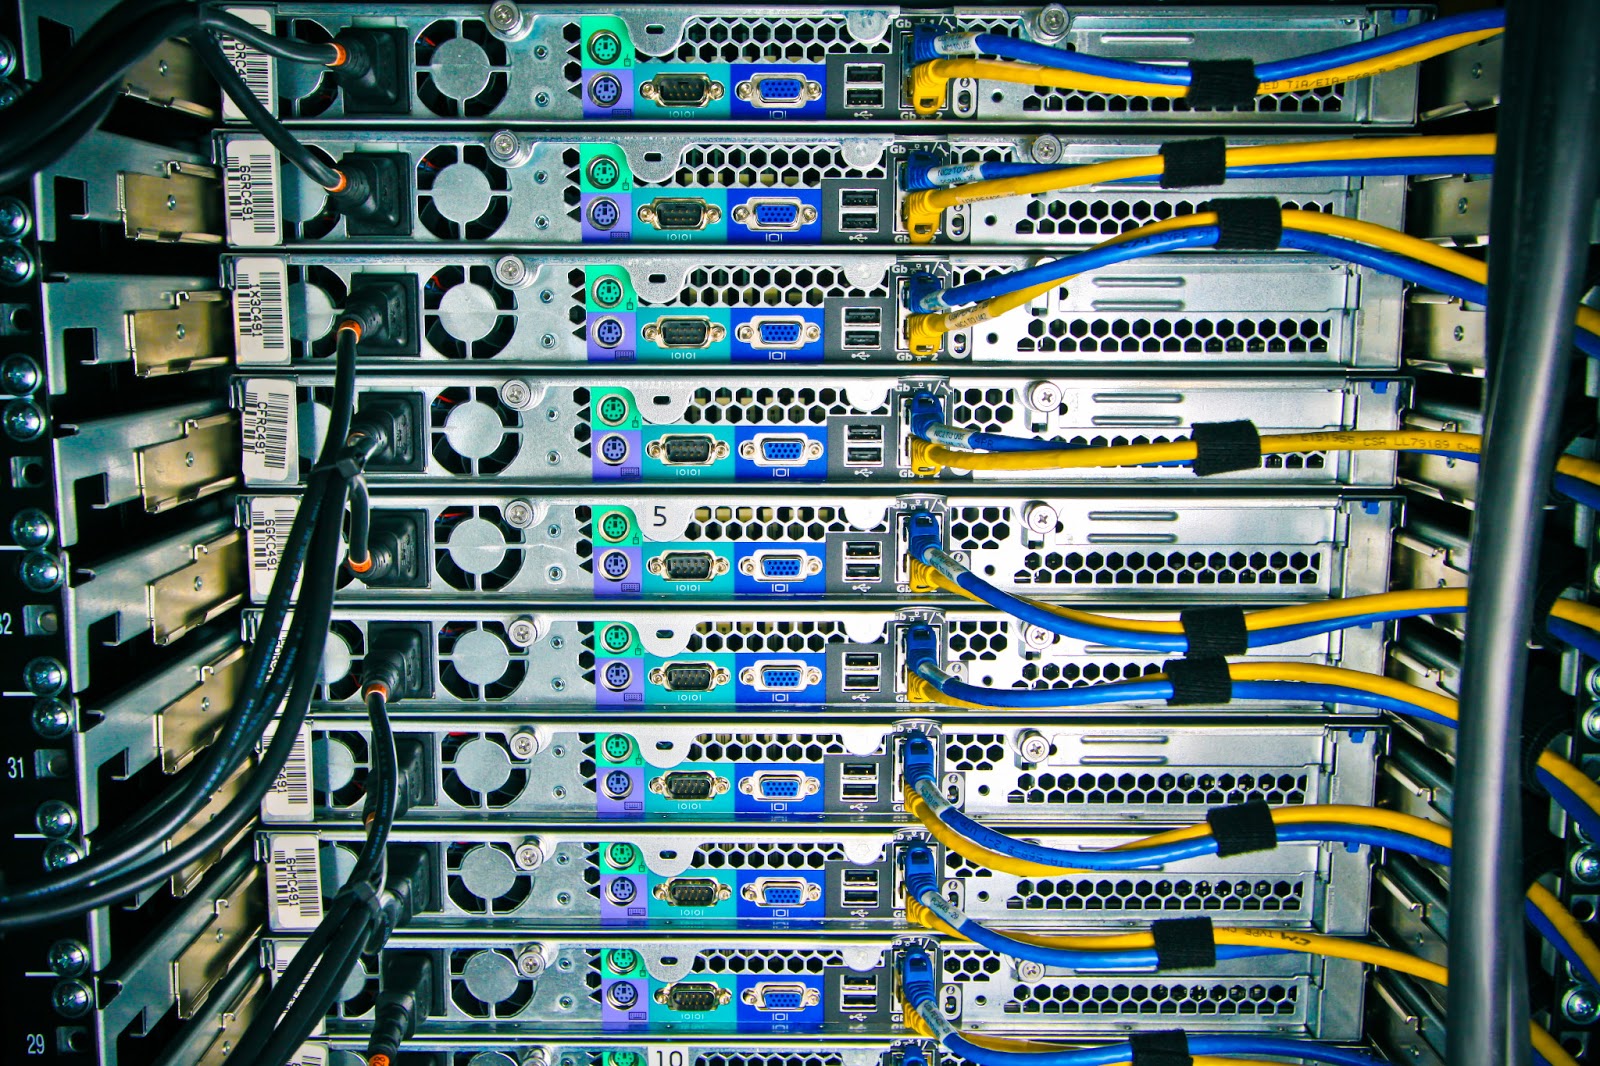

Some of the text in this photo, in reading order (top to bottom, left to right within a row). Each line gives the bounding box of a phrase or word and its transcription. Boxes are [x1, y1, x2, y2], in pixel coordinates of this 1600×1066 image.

[900, 112, 943, 120] Gb 2
[890, 144, 906, 154] Gb
[240, 165, 253, 222] 6GRC491
[894, 235, 910, 243] Gb
[892, 264, 908, 273] Gb
[249, 283, 263, 337] 1X3C491
[896, 353, 913, 361] Gb
[895, 384, 910, 392] Gb
[254, 402, 267, 455] CFRC491
[1363, 437, 1386, 447] CSA
[899, 470, 914, 478] Gb
[653, 506, 667, 527] 5
[264, 519, 278, 572] 6GKC491
[8, 758, 25, 778] 31
[286, 858, 299, 907] 6HMC491
[27, 1034, 46, 1055] 29
[656, 1050, 683, 1066] 10
